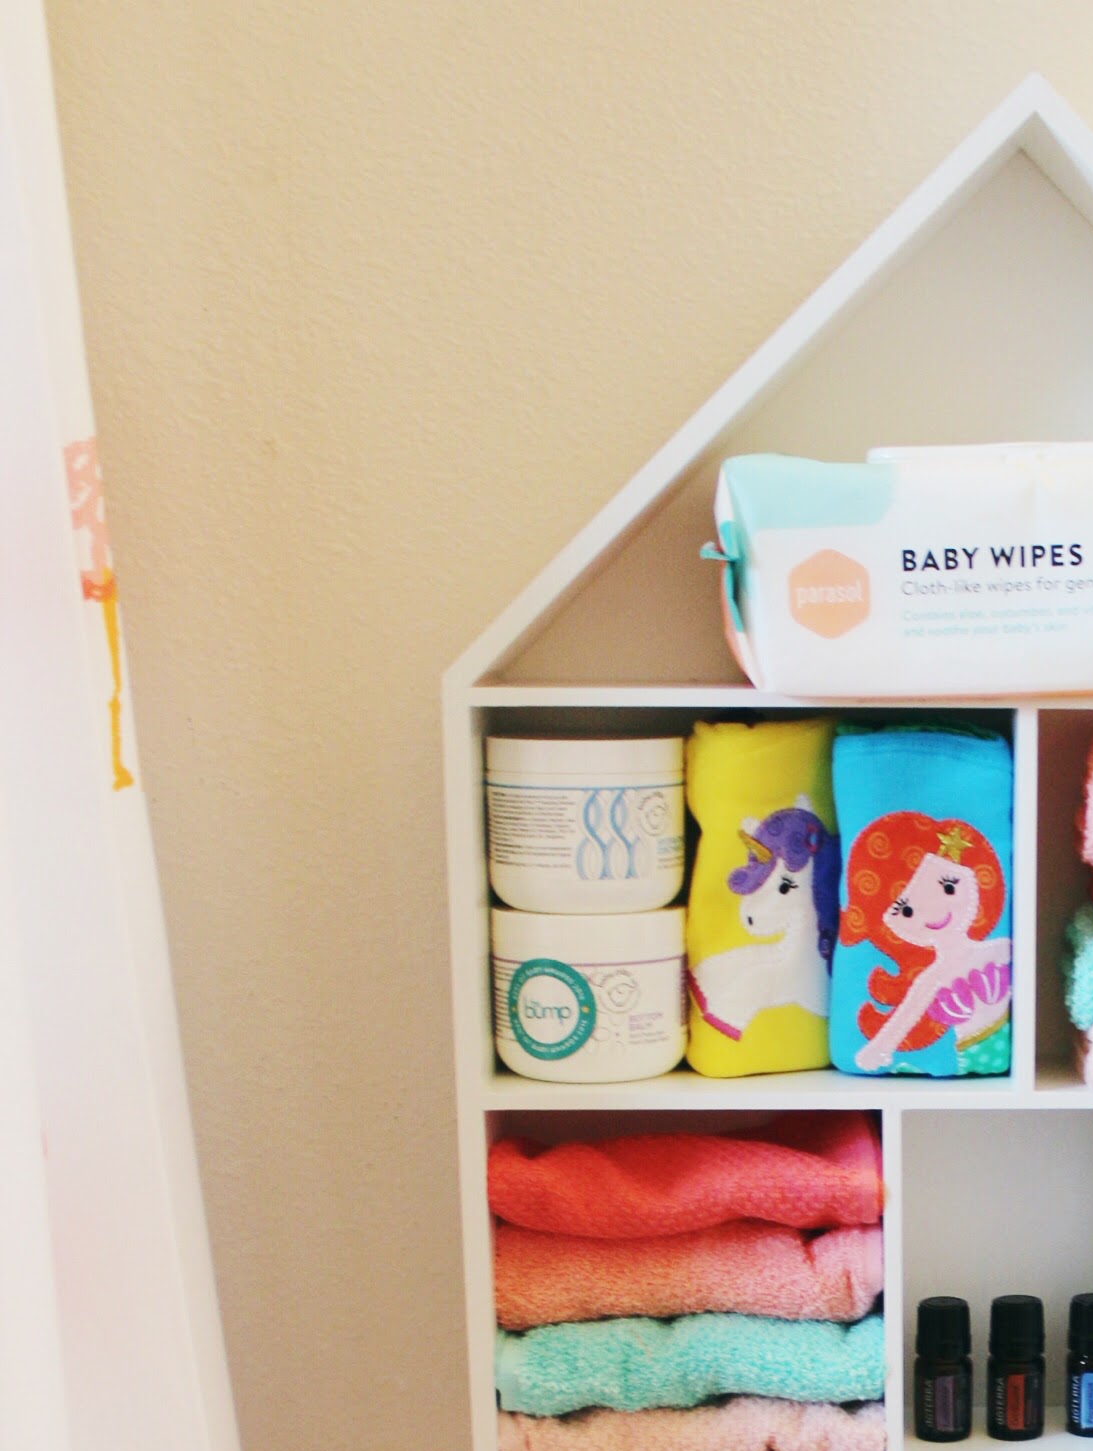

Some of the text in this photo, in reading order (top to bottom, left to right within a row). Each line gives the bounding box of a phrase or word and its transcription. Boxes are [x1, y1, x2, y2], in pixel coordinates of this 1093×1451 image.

[902, 543, 1084, 572] BABY WIPES
[901, 579, 981, 596] Cloth-like
[986, 578, 1032, 596] wipes
[1036, 575, 1062, 592] for
[523, 998, 572, 1026] bump
